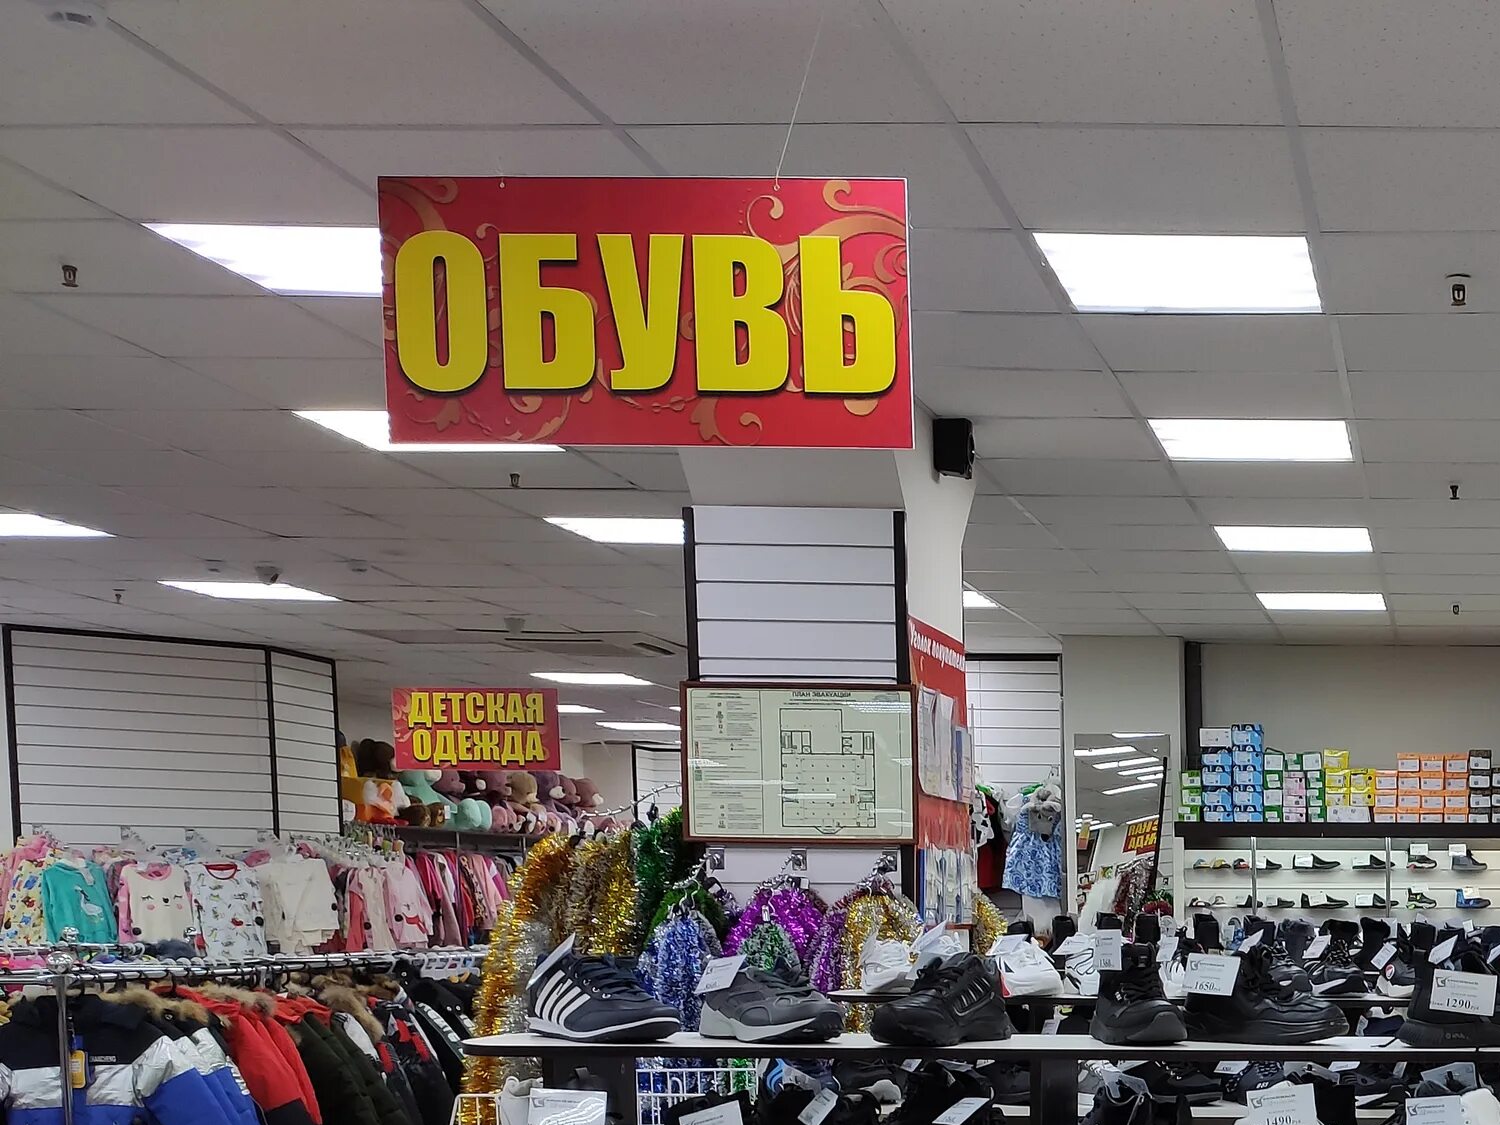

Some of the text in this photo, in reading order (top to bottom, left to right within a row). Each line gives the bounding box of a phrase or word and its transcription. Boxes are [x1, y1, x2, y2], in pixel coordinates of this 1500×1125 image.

[394, 230, 896, 395] ОБУВЬ
[408, 692, 545, 728] ДЕТСКАЯ
[412, 729, 545, 766] ОДЕЖДА
[1446, 998, 1471, 1008] 1290
